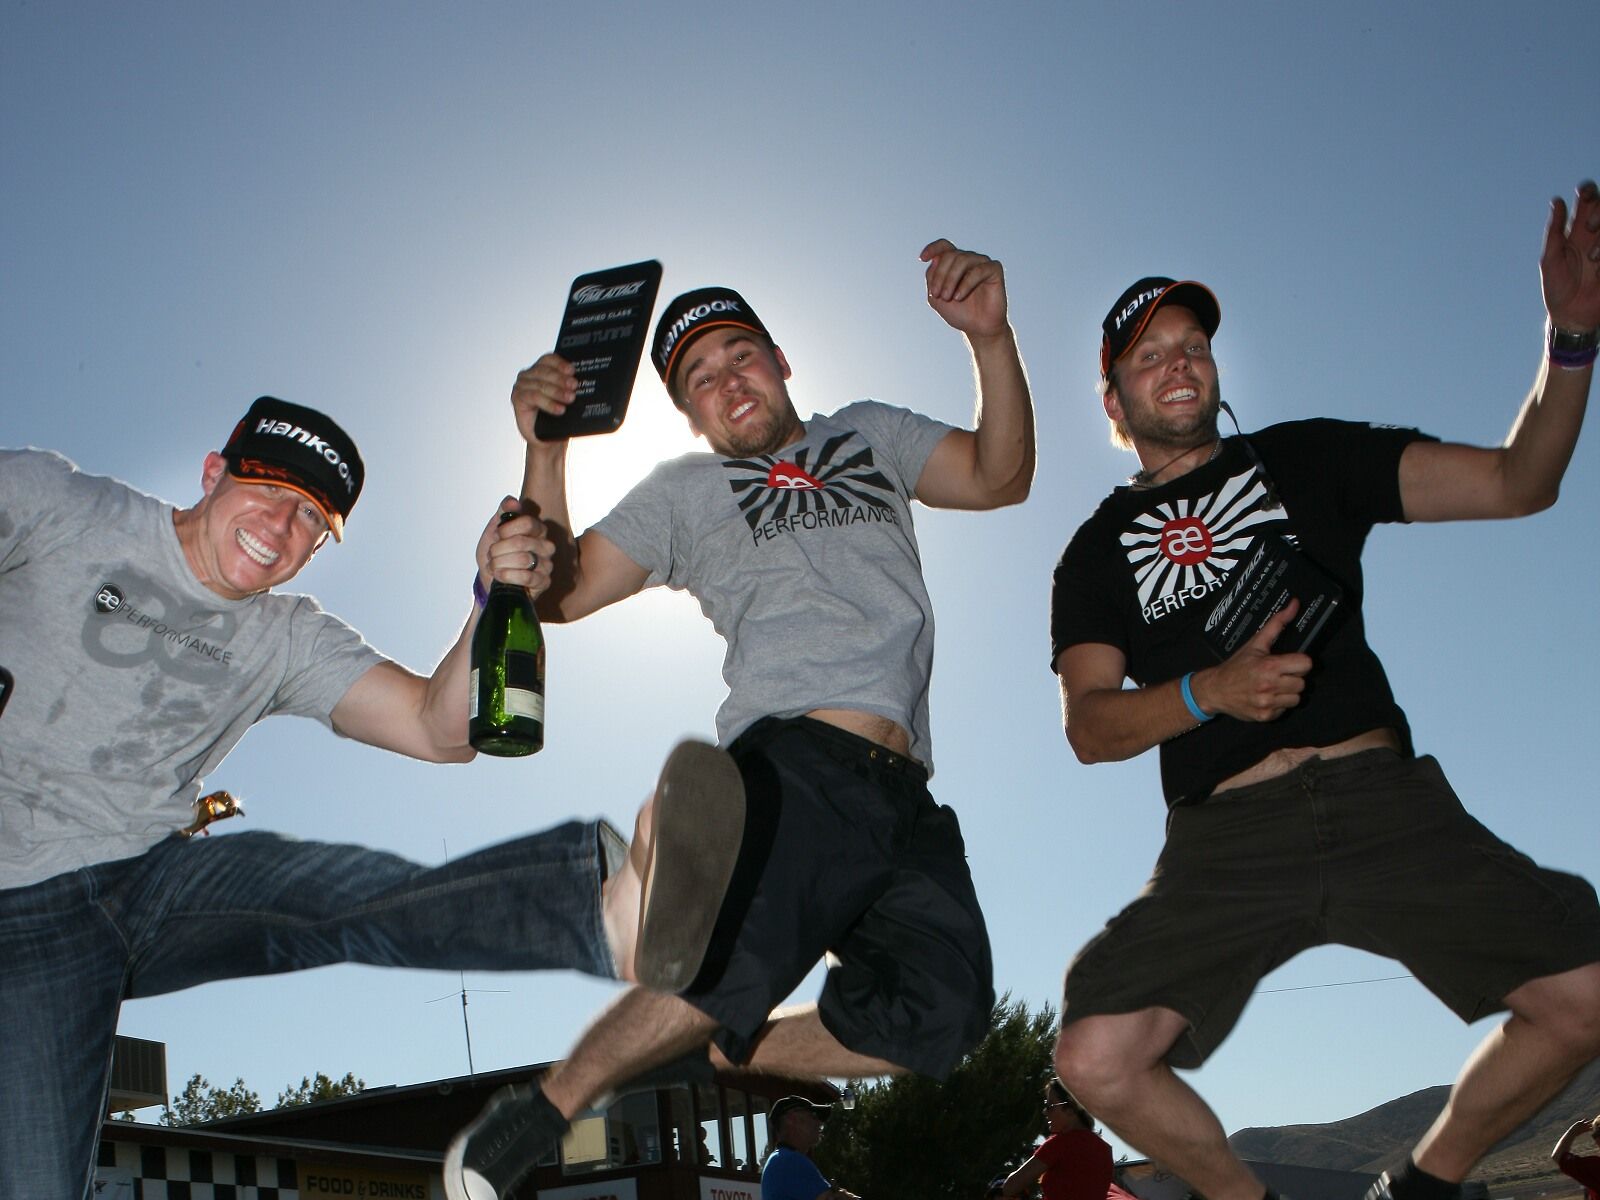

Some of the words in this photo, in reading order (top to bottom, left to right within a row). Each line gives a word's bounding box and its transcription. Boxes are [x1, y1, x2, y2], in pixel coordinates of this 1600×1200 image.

[752, 505, 900, 547] PERFORMANCE
[1222, 592, 1252, 636] MODIFIED
[1252, 560, 1274, 590] CLASS
[118, 603, 233, 665] PERFORMANCE
[306, 1175, 354, 1195] FOOD
[368, 1181, 426, 1200] DRINKS
